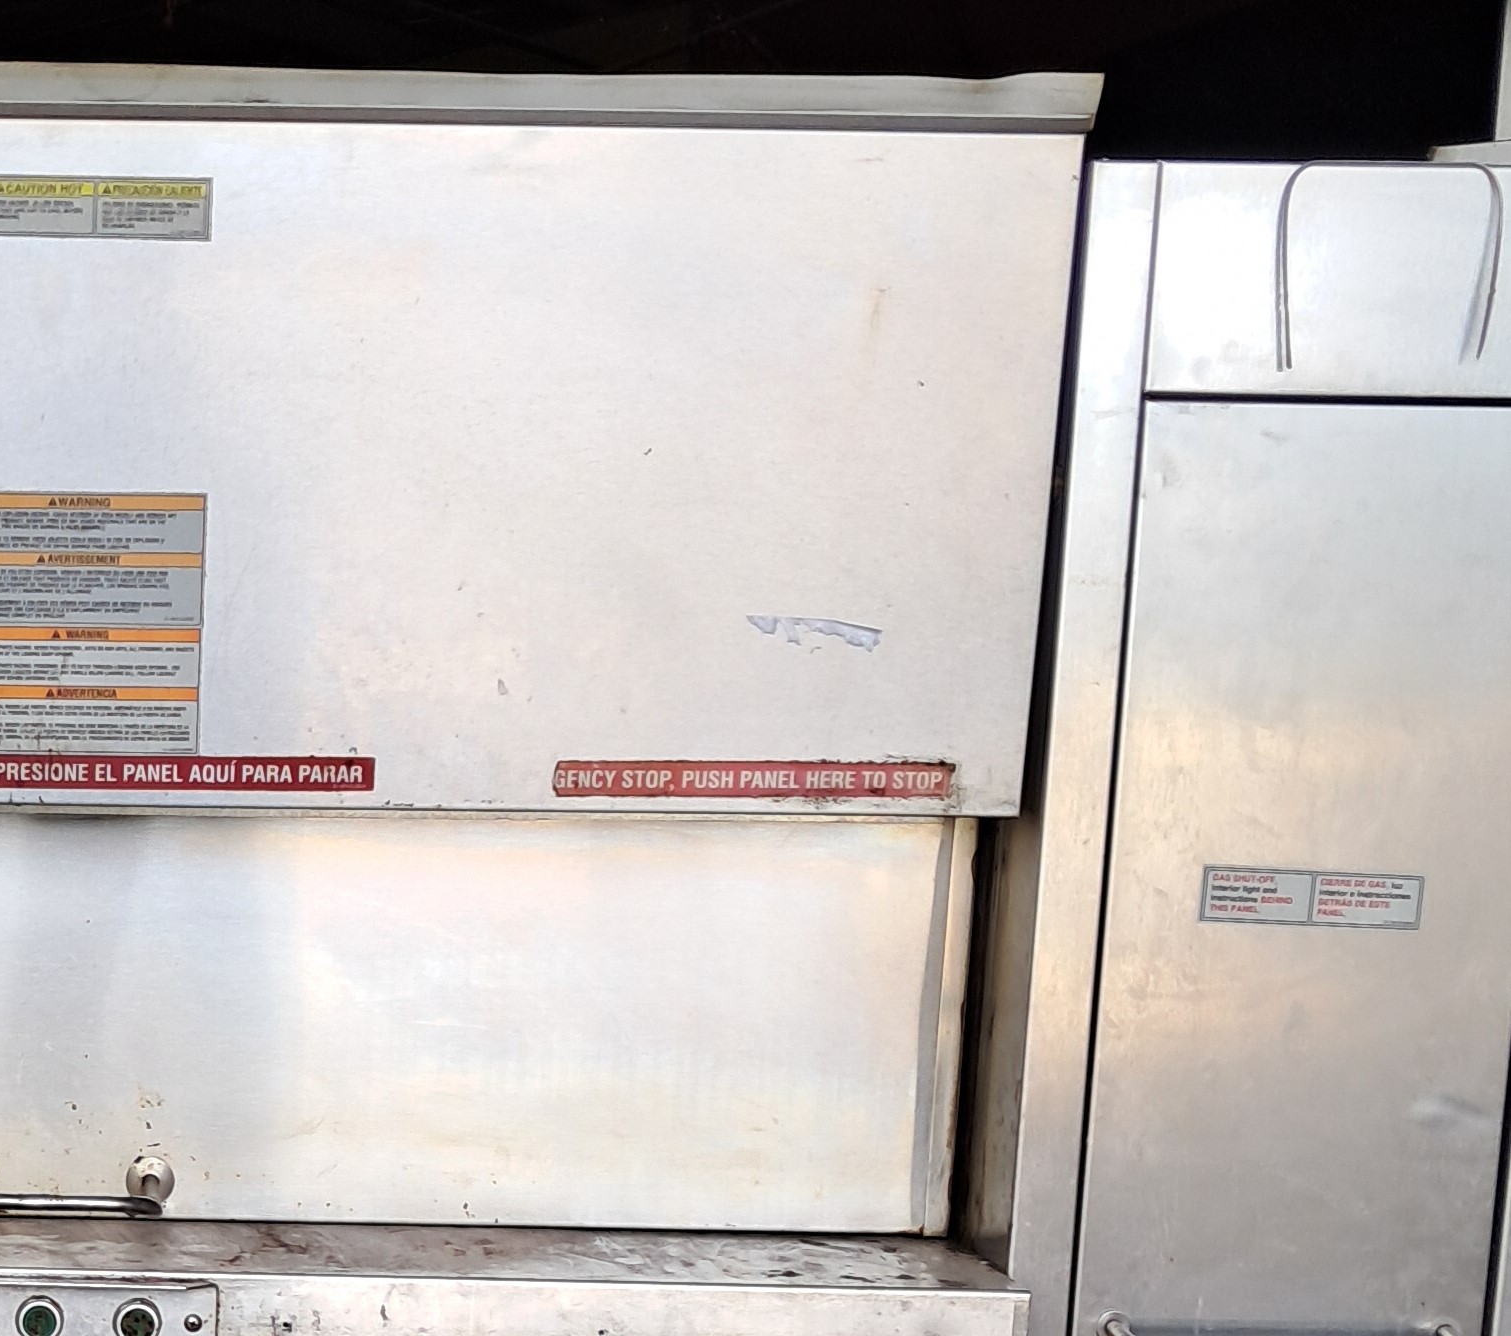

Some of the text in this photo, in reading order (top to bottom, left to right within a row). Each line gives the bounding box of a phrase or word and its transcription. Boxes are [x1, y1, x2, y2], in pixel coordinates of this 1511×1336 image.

[6, 183, 82, 194] CAUTION HOT
[58, 497, 111, 507] WARNING
[48, 554, 120, 565] AVERTISSEMENT
[65, 630, 109, 639] WARNING
[57, 688, 117, 698] ADVERTENCIA
[95, 763, 118, 782] EL
[123, 763, 184, 783] PANEL
[189, 760, 238, 784] AQUÍ
[242, 764, 293, 783] PARA
[299, 764, 363, 783] PARAR
[621, 769, 675, 791] STOP,
[681, 770, 734, 789] PUSH
[740, 770, 800, 789] PANEL
[806, 770, 857, 790] HERE
[861, 771, 887, 789] TO
[892, 771, 944, 790] STOP
[1213, 873, 1230, 881] GAS
